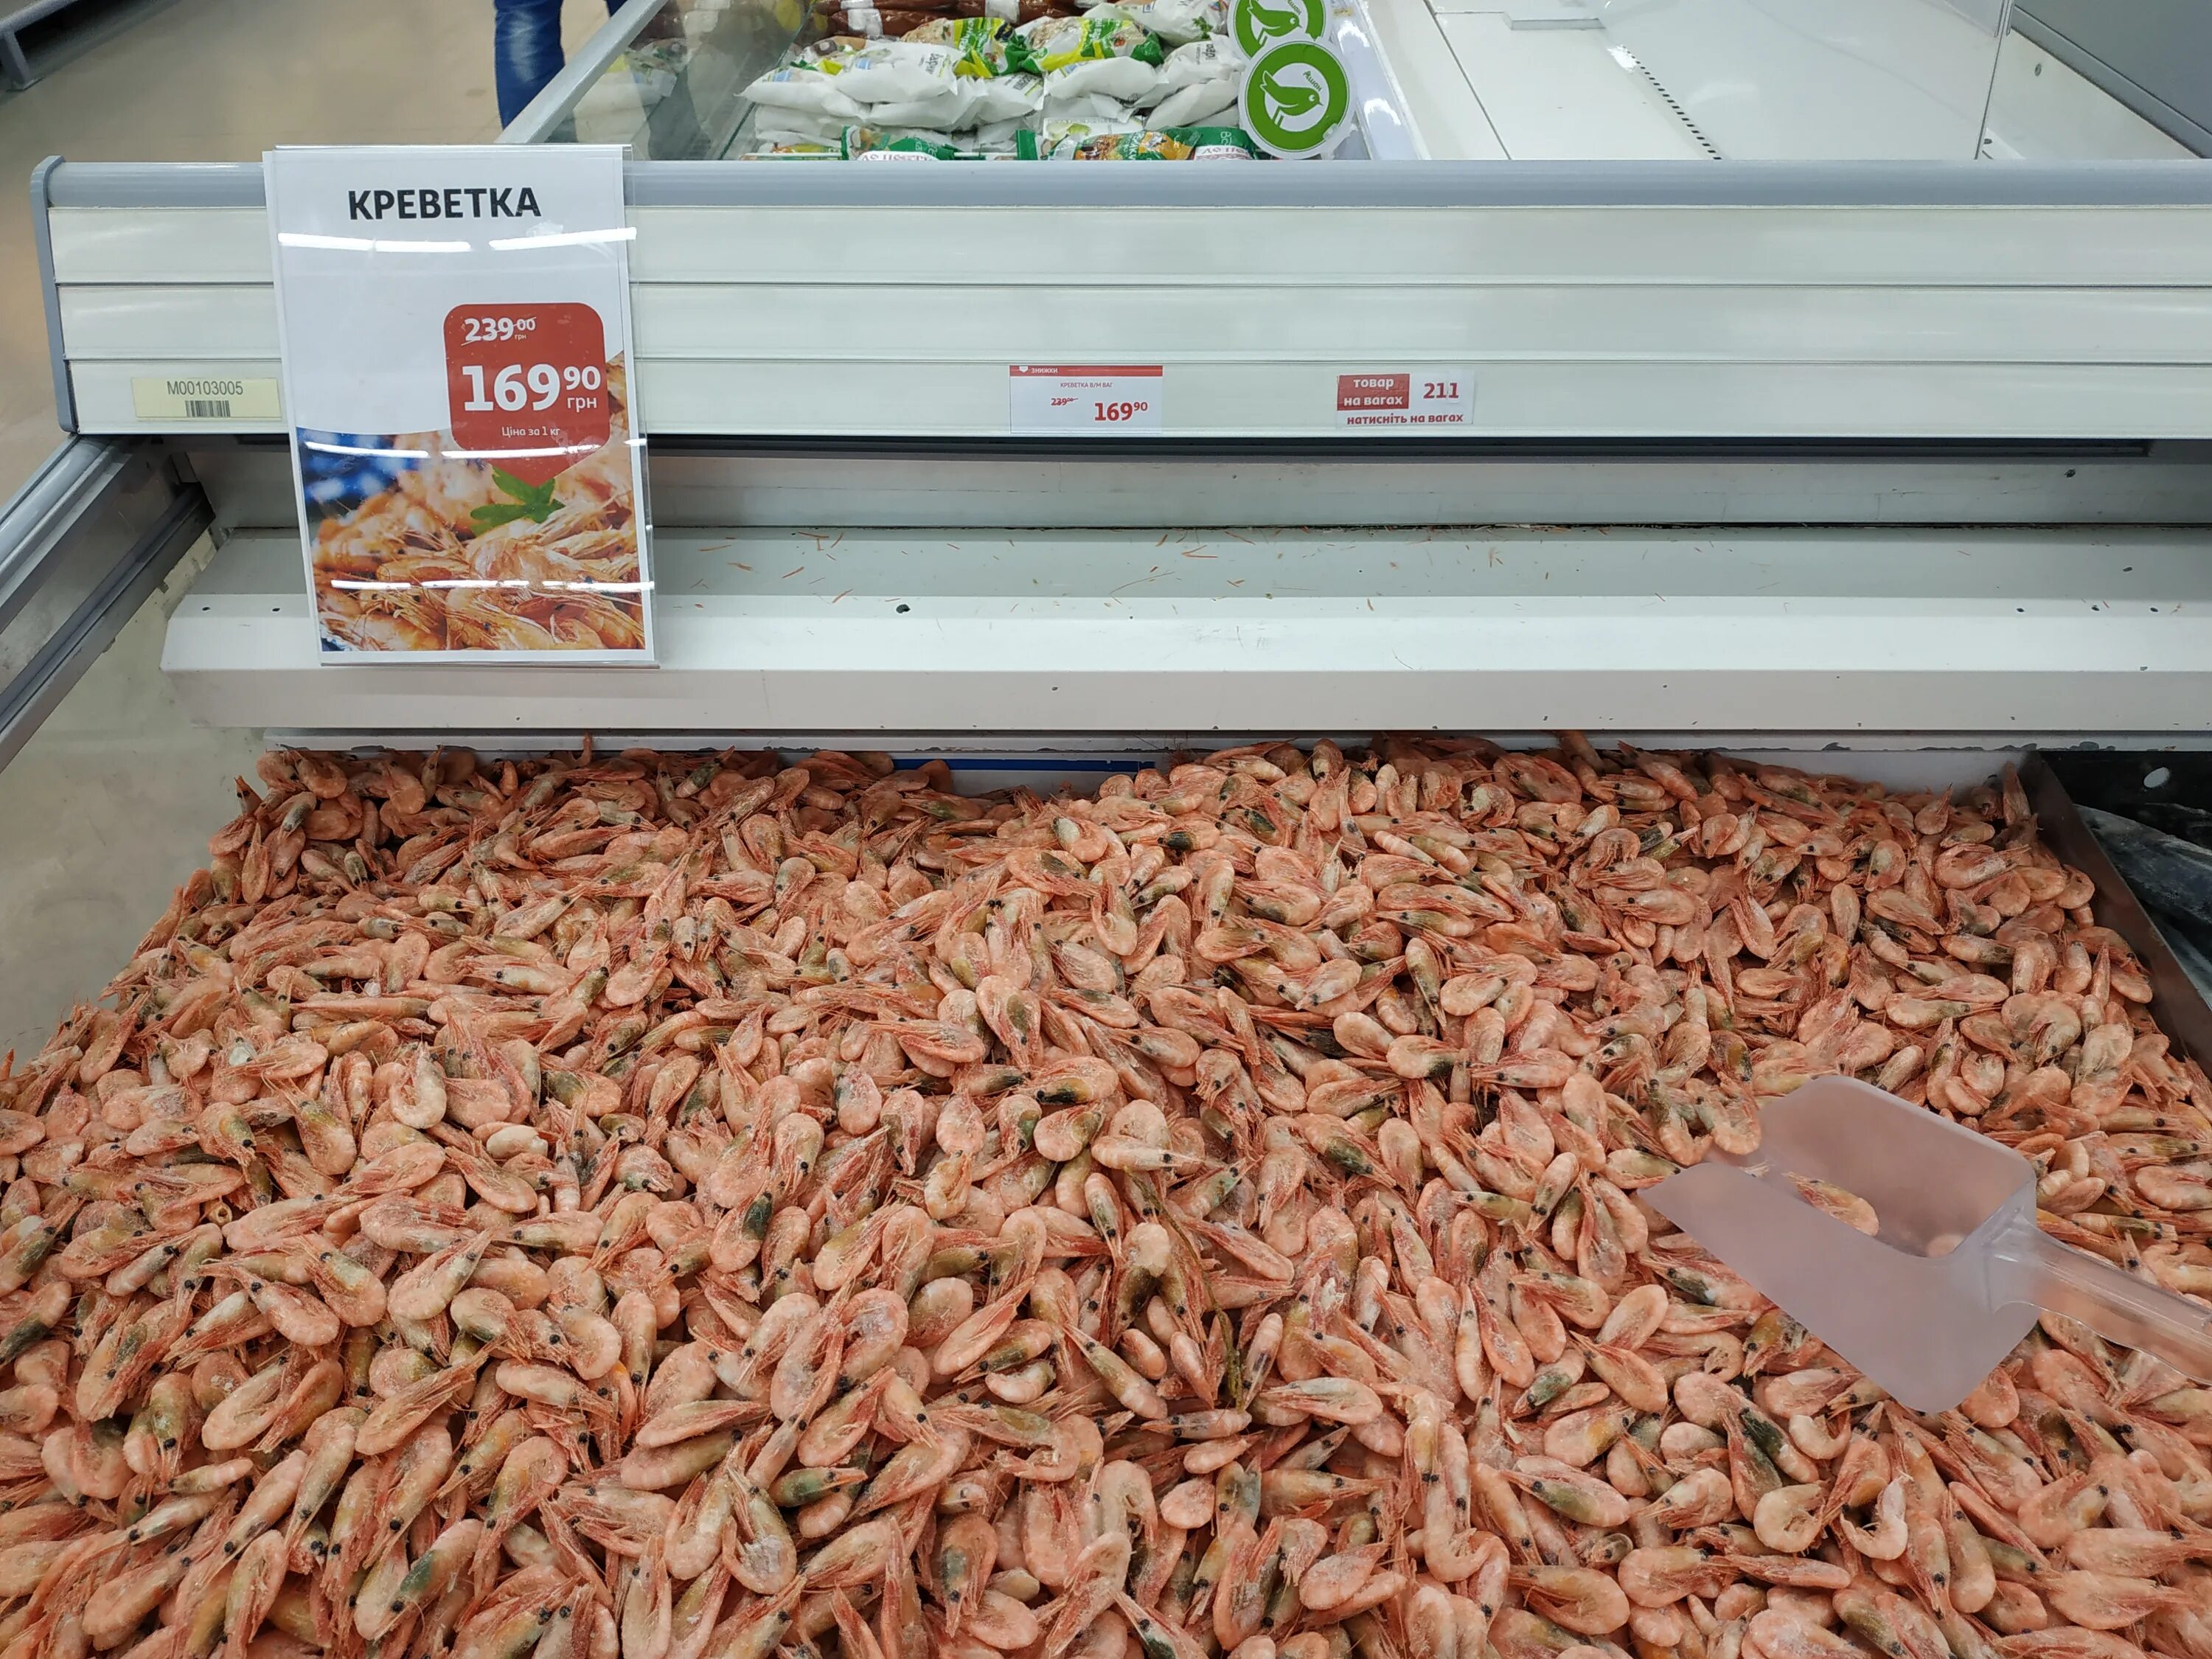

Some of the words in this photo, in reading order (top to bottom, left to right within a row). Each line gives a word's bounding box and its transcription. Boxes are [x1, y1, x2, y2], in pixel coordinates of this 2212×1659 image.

[348, 187, 542, 220] КРЕВЕТКА
[167, 380, 244, 395] M00103005
[1353, 378, 1394, 390] товар
[1423, 383, 1459, 399] 211
[567, 397, 597, 413] грн
[1344, 397, 1360, 406] на
[1364, 396, 1403, 406] вагах
[1347, 413, 1408, 425] натисніть
[1410, 414, 1425, 423] на
[1428, 414, 1464, 423] вагах
[501, 426, 526, 437] Ціна
[528, 428, 540, 437] за
[542, 427, 548, 437] 1
[550, 428, 560, 437] кг
